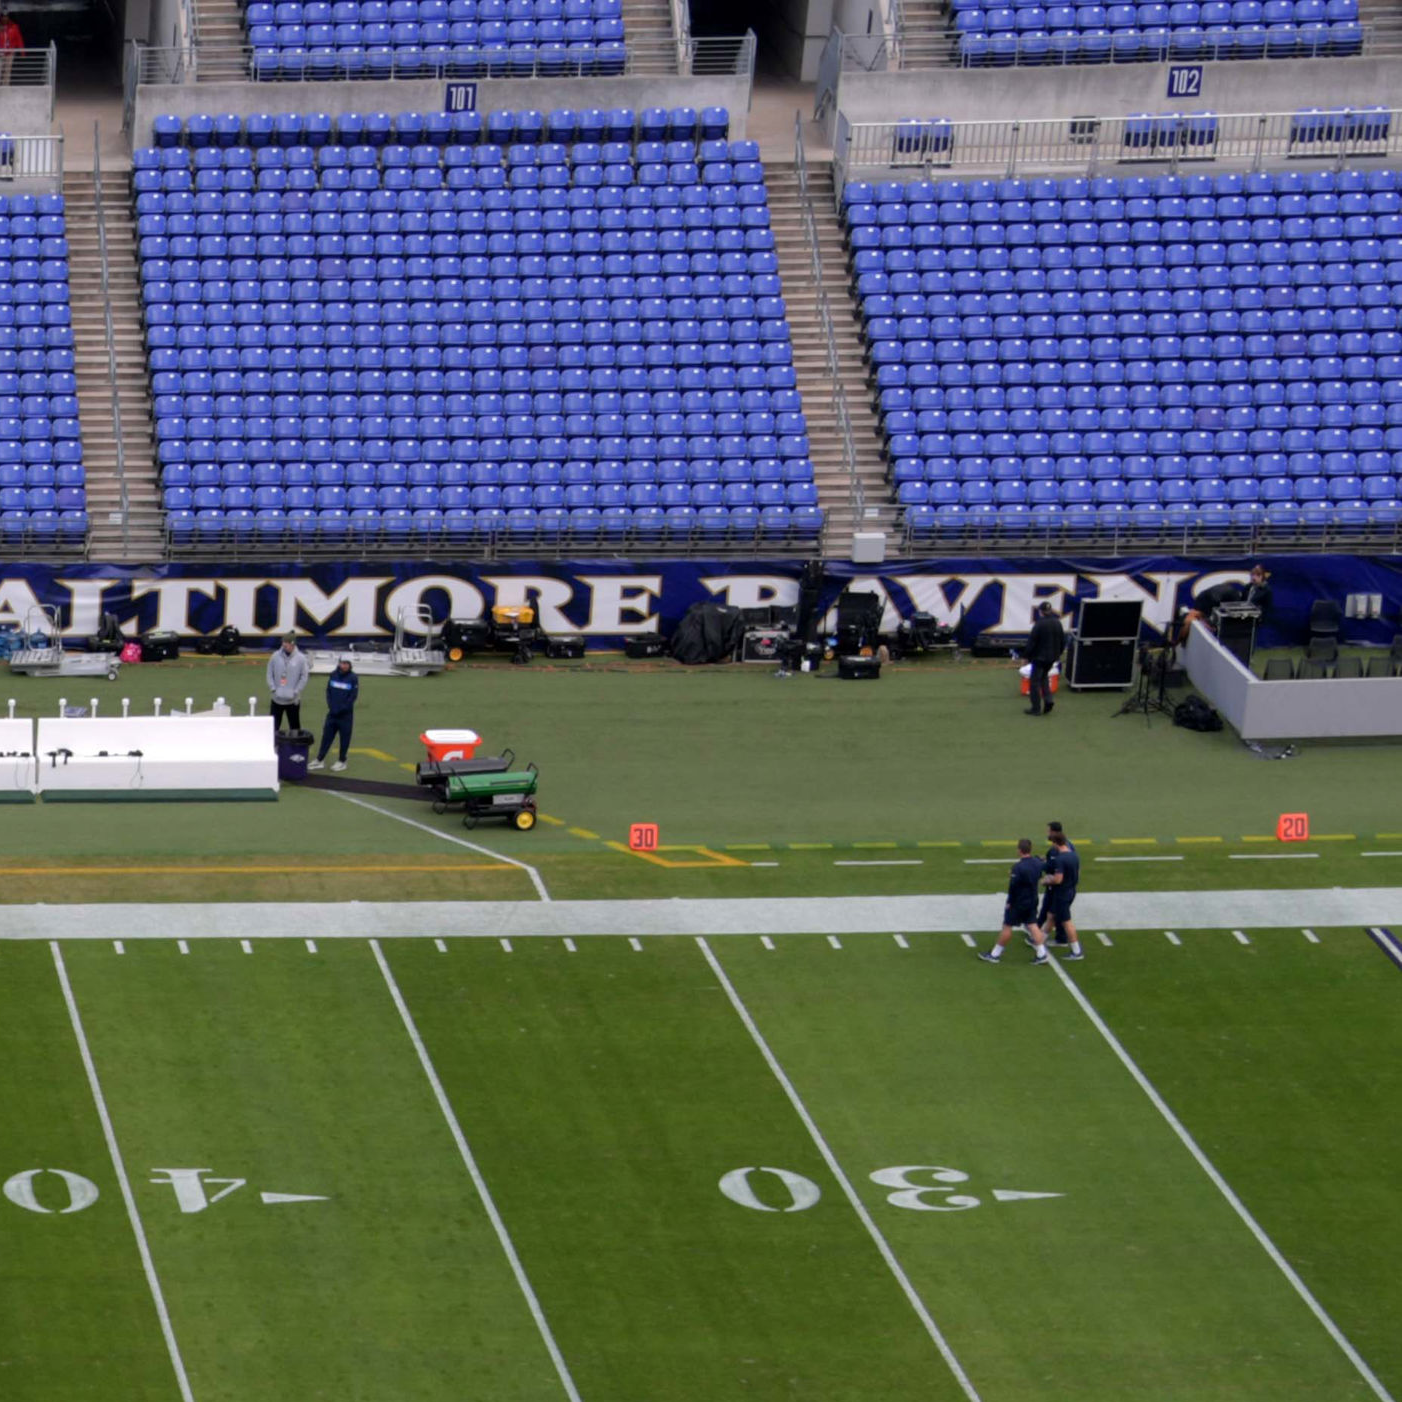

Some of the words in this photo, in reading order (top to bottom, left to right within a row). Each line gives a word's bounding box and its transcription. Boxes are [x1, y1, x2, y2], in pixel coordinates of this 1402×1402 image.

[1172, 69, 1200, 94] 102
[450, 86, 473, 110] 101
[633, 828, 654, 848] 30
[1283, 817, 1305, 838] 20
